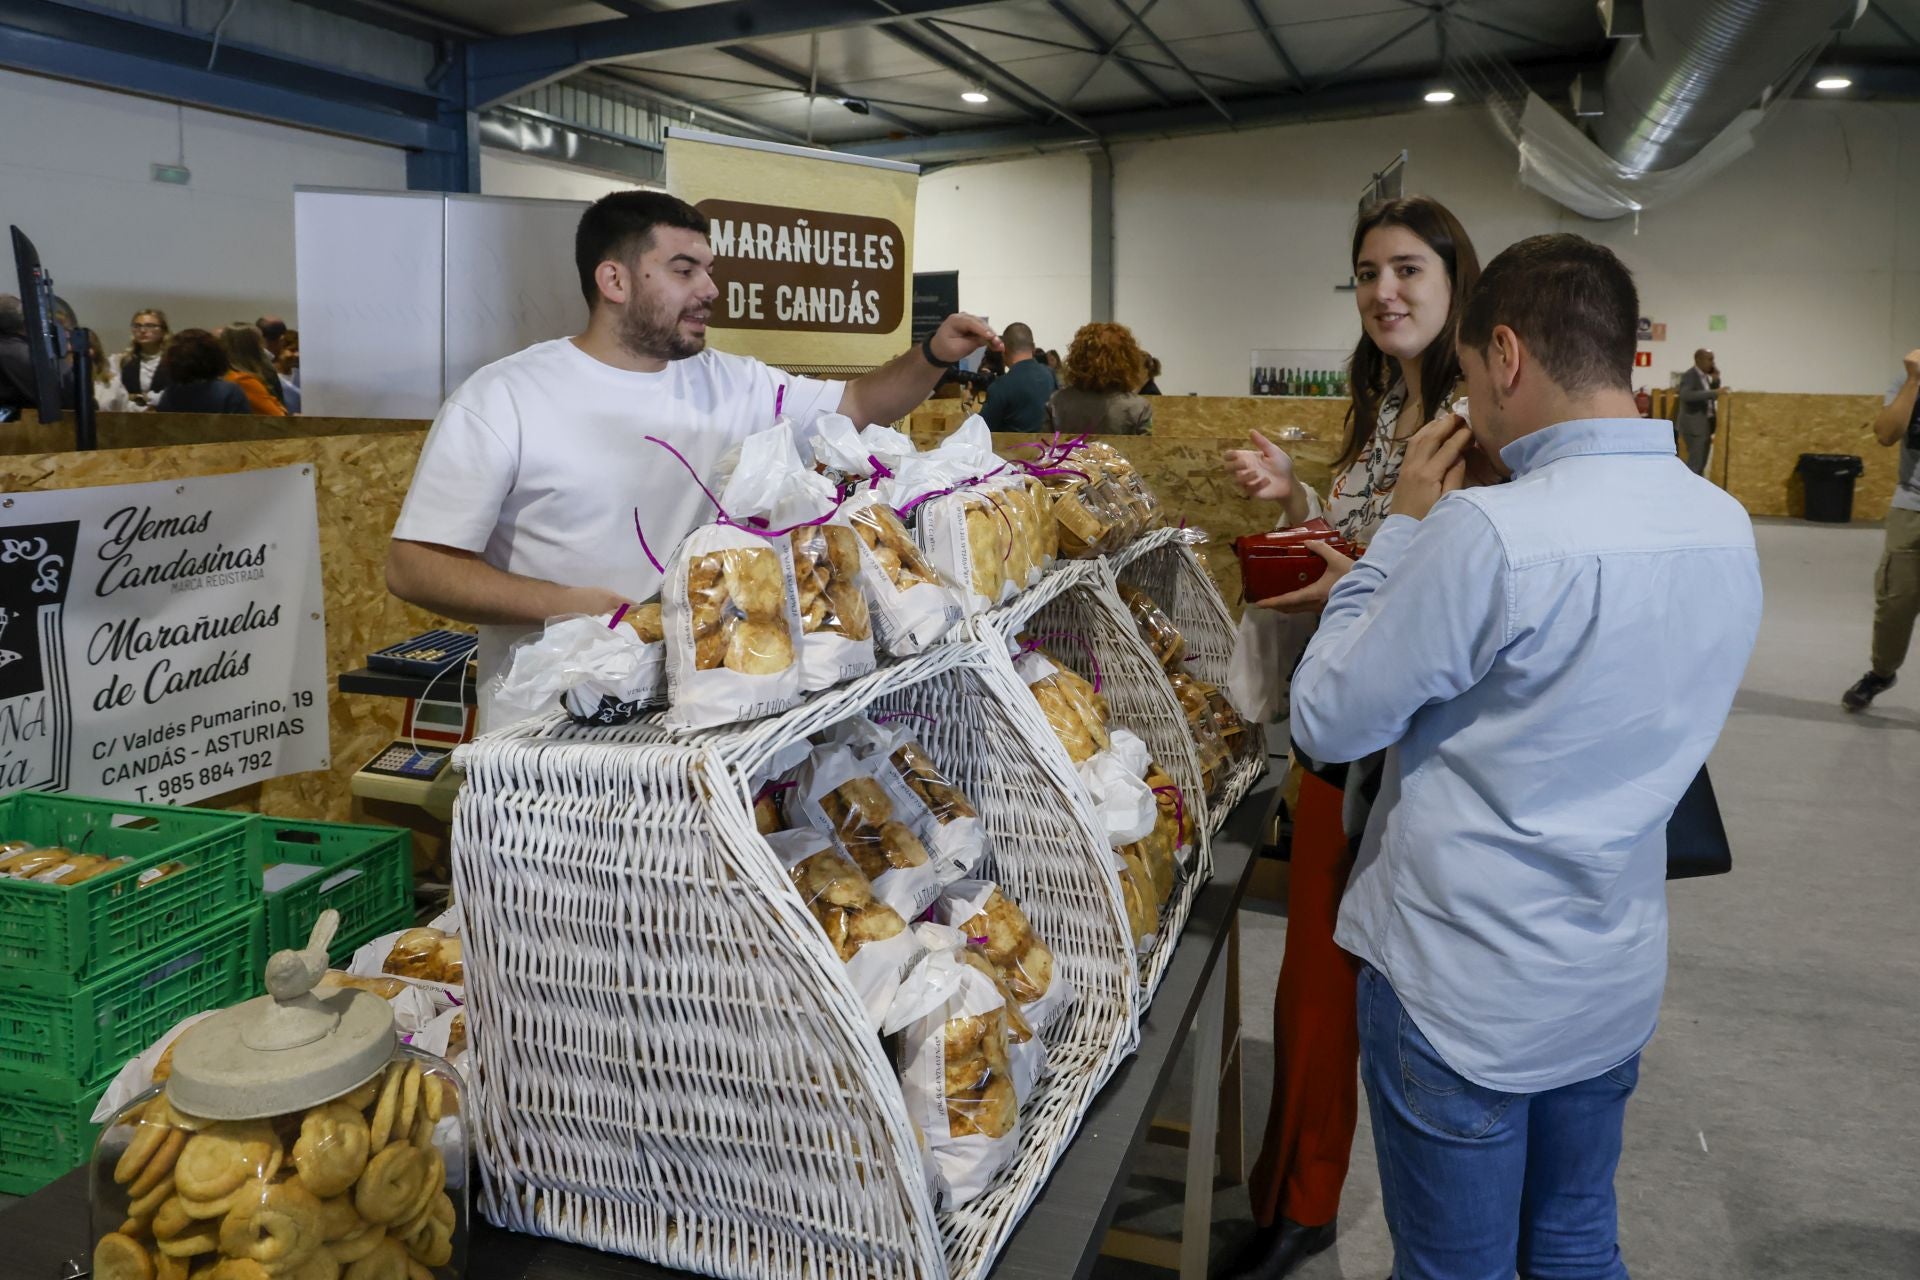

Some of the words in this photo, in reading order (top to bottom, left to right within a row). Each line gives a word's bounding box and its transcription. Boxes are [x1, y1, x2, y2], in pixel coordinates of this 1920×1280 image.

[709, 218, 894, 271] MARAÑUELES
[726, 281, 765, 320] DE
[775, 279, 880, 325] CANDÁS
[98, 506, 212, 560] Yemas
[171, 577, 203, 594] MARCA
[206, 568, 265, 588] REGISTRADA
[87, 601, 281, 666] Marañuelas
[92, 674, 136, 712] de
[144, 650, 251, 705] Candás
[92, 737, 117, 761] C/
[123, 722, 186, 752] Valdés
[191, 698, 287, 734] Pumarino,
[292, 690, 314, 708] 19
[102, 746, 186, 786] CANDÁS
[204, 718, 304, 757] ASTURIAS
[134, 785, 154, 804] T.
[158, 772, 195, 798] 985
[199, 761, 234, 786] 884
[238, 750, 273, 774] 792
